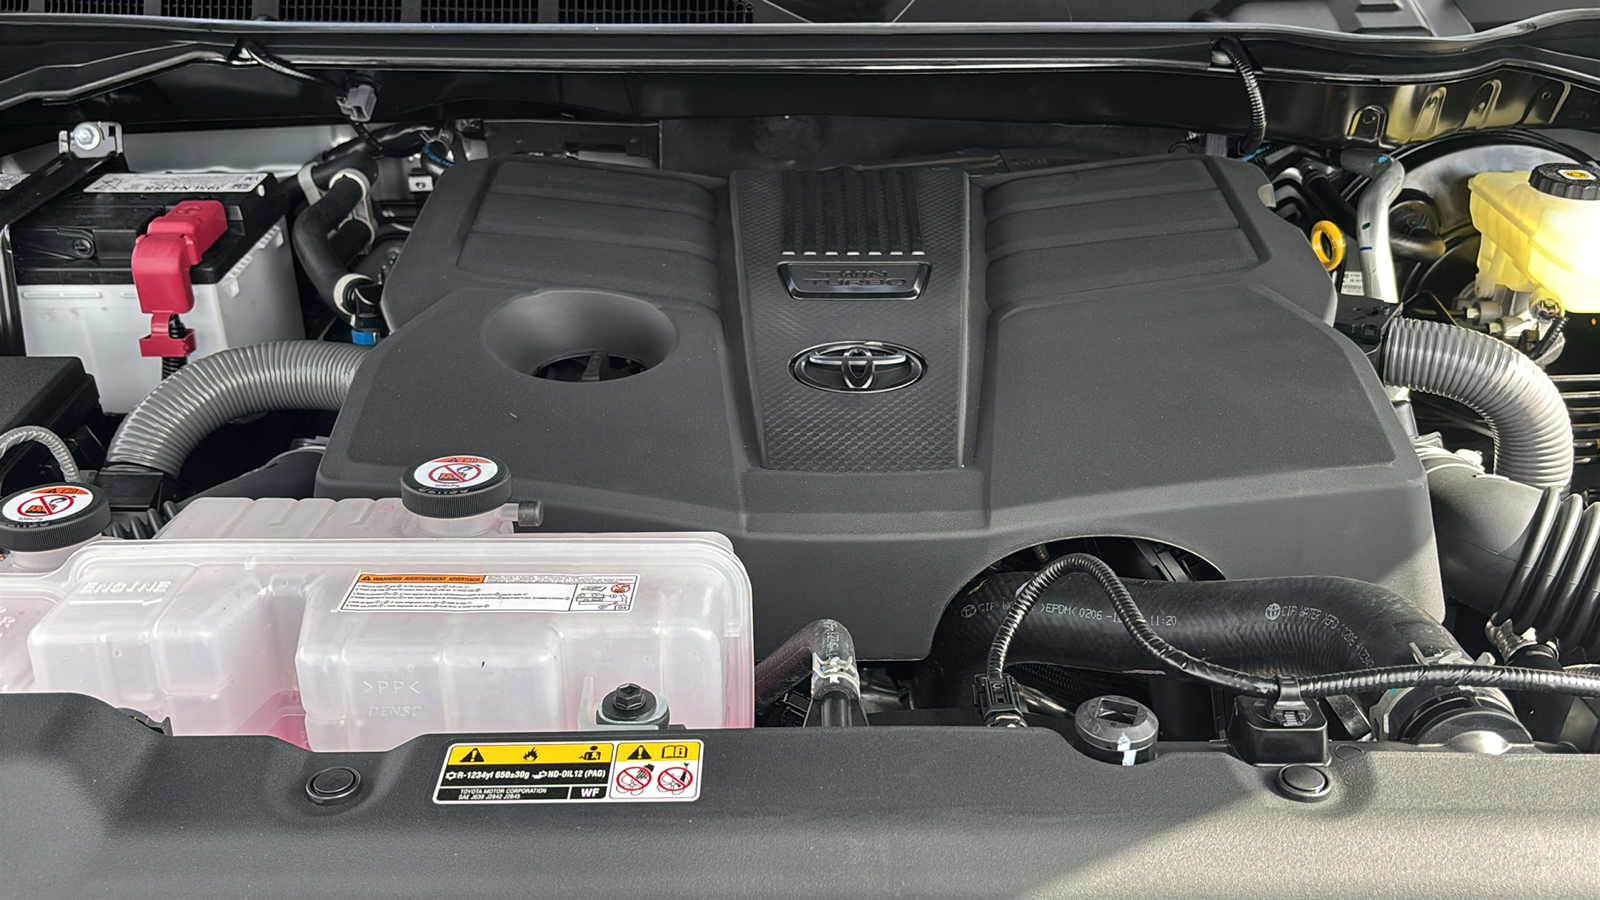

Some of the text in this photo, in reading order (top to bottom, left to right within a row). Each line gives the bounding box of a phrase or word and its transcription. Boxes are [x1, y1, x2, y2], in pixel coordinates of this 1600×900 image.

[803, 278, 907, 286] TURBO
[79, 581, 172, 594] ENGINE
[1079, 607, 1103, 620] 0206
[1150, 615, 1177, 626] 11:20
[368, 706, 422, 717] DENSO
[457, 771, 493, 780] R-1234yf
[495, 771, 530, 779] 650±30g
[584, 770, 606, 779] (PAG)
[581, 788, 600, 798] WF
